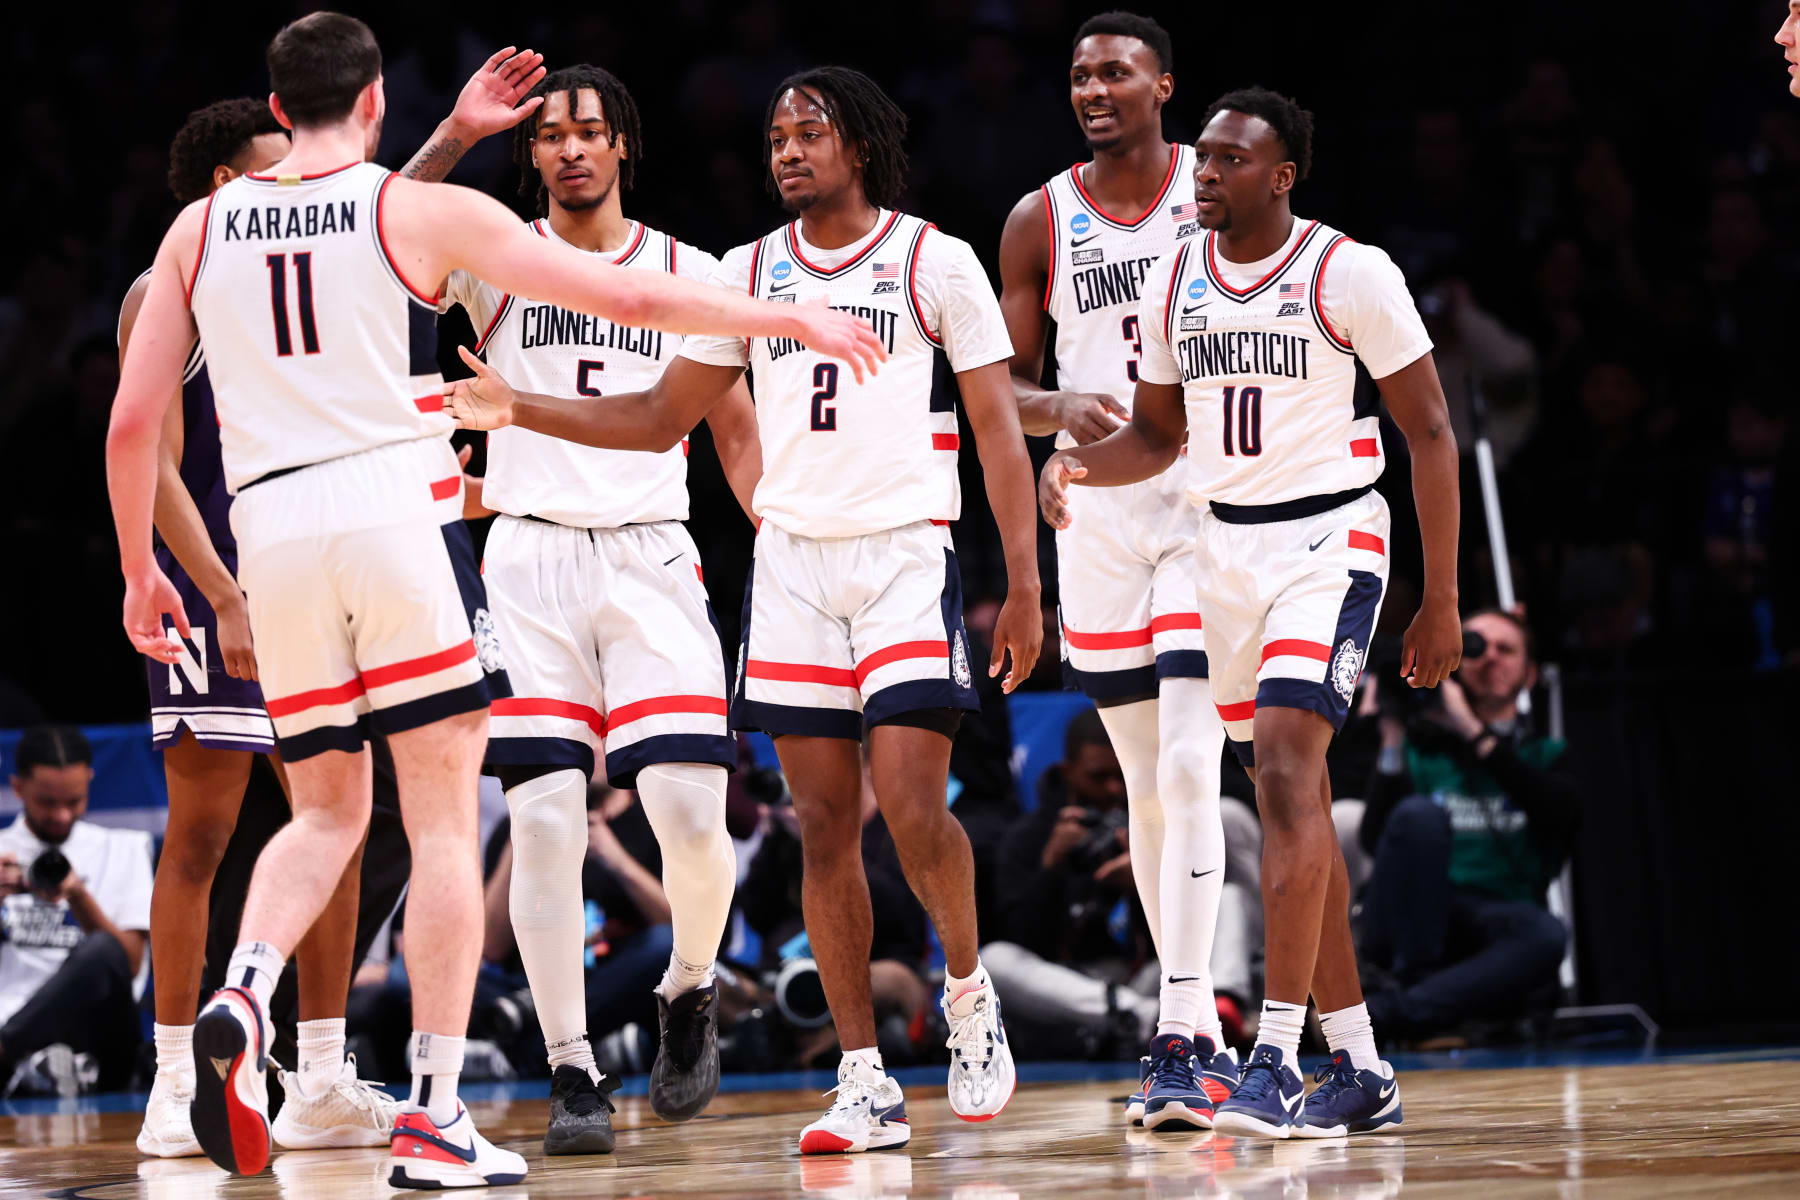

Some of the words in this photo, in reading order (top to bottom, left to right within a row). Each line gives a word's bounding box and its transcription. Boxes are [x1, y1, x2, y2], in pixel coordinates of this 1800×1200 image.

[224, 200, 356, 242] KARABAN
[266, 252, 321, 357] 11
[1072, 256, 1160, 314] CONNEC
[1177, 331, 1310, 382] CONNECTICUT
[811, 362, 839, 431] 2
[1223, 386, 1263, 457] 10
[167, 627, 209, 695] N
